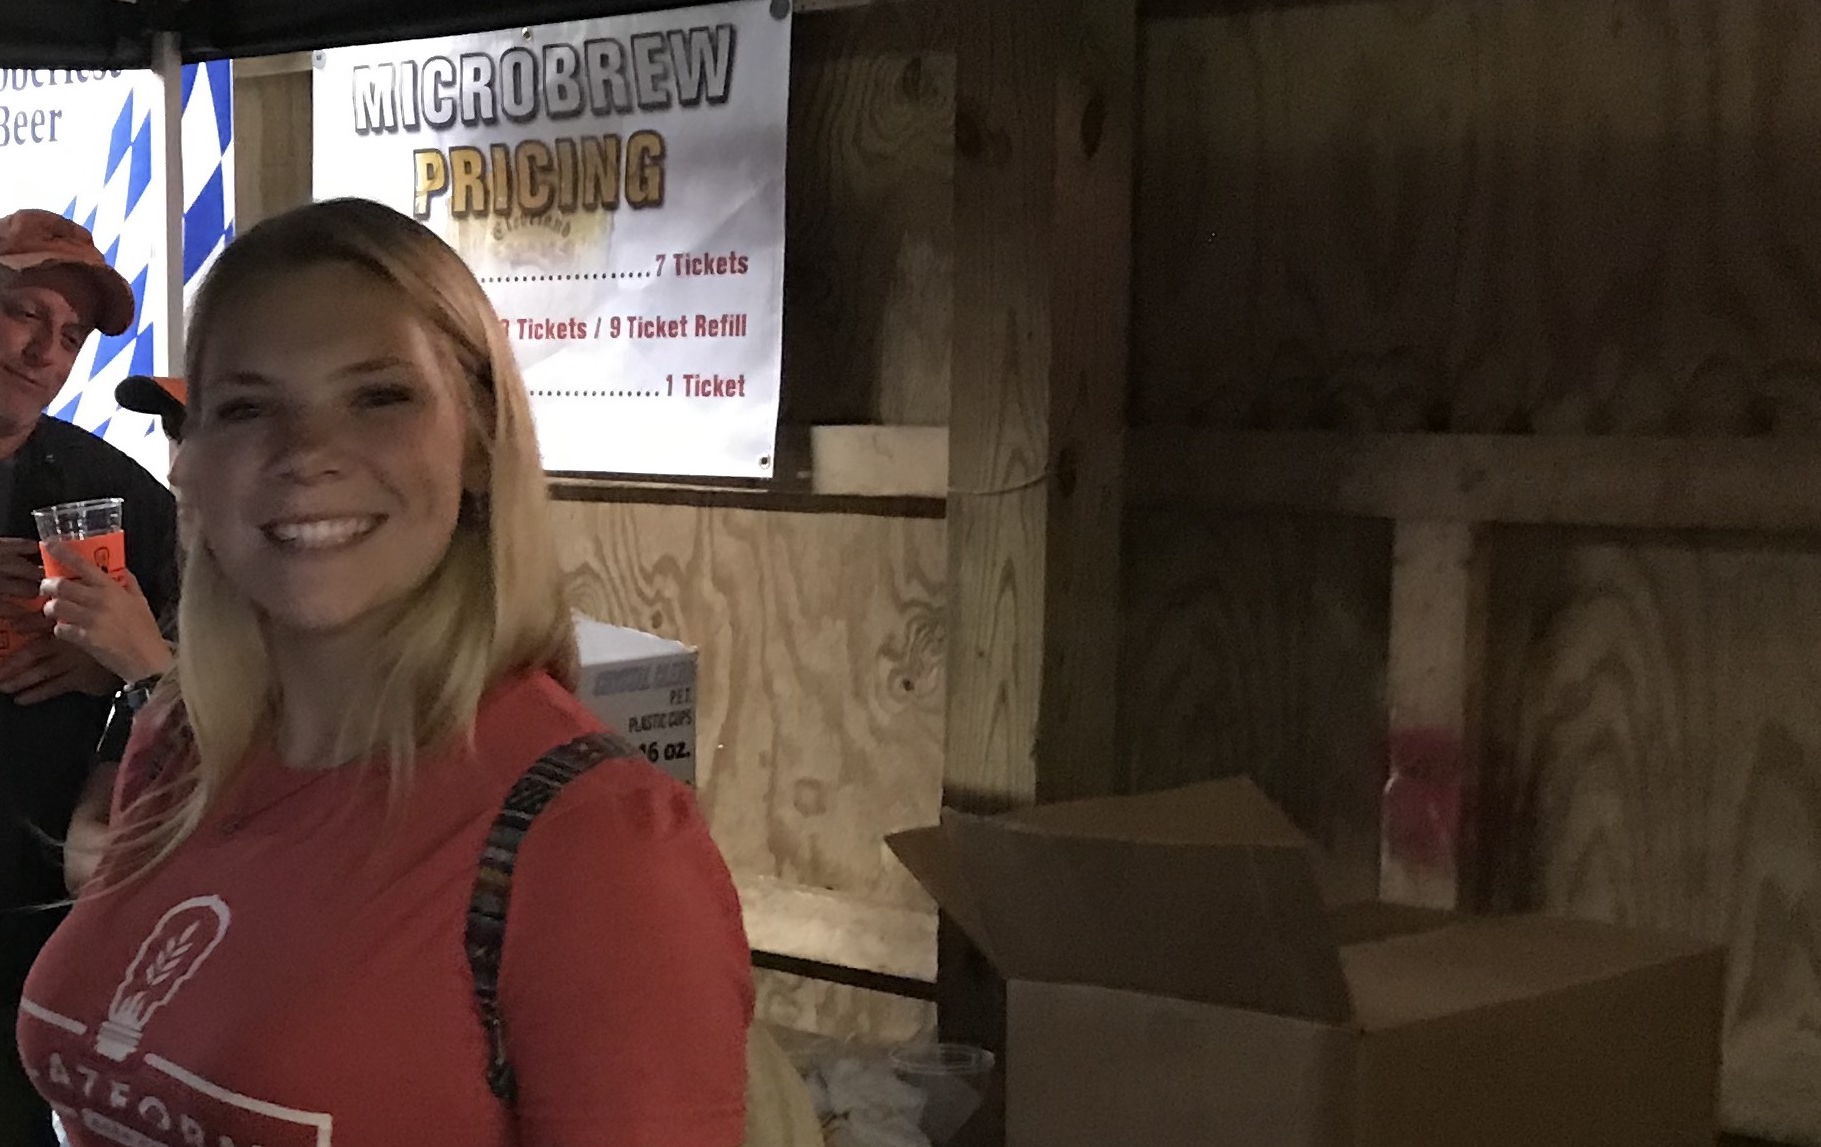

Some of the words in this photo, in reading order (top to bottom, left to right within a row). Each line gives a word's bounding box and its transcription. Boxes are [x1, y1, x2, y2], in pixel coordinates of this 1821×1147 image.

[353, 23, 735, 134] MICROBREW
[413, 129, 667, 219] PRICING
[655, 253, 667, 277] 7
[673, 251, 749, 276] Tickets
[516, 317, 587, 340] Tickets
[609, 316, 621, 338] 9
[627, 314, 688, 338] Ticket
[694, 313, 747, 337] Refill
[666, 374, 674, 397] 1
[682, 374, 746, 397] Ticket
